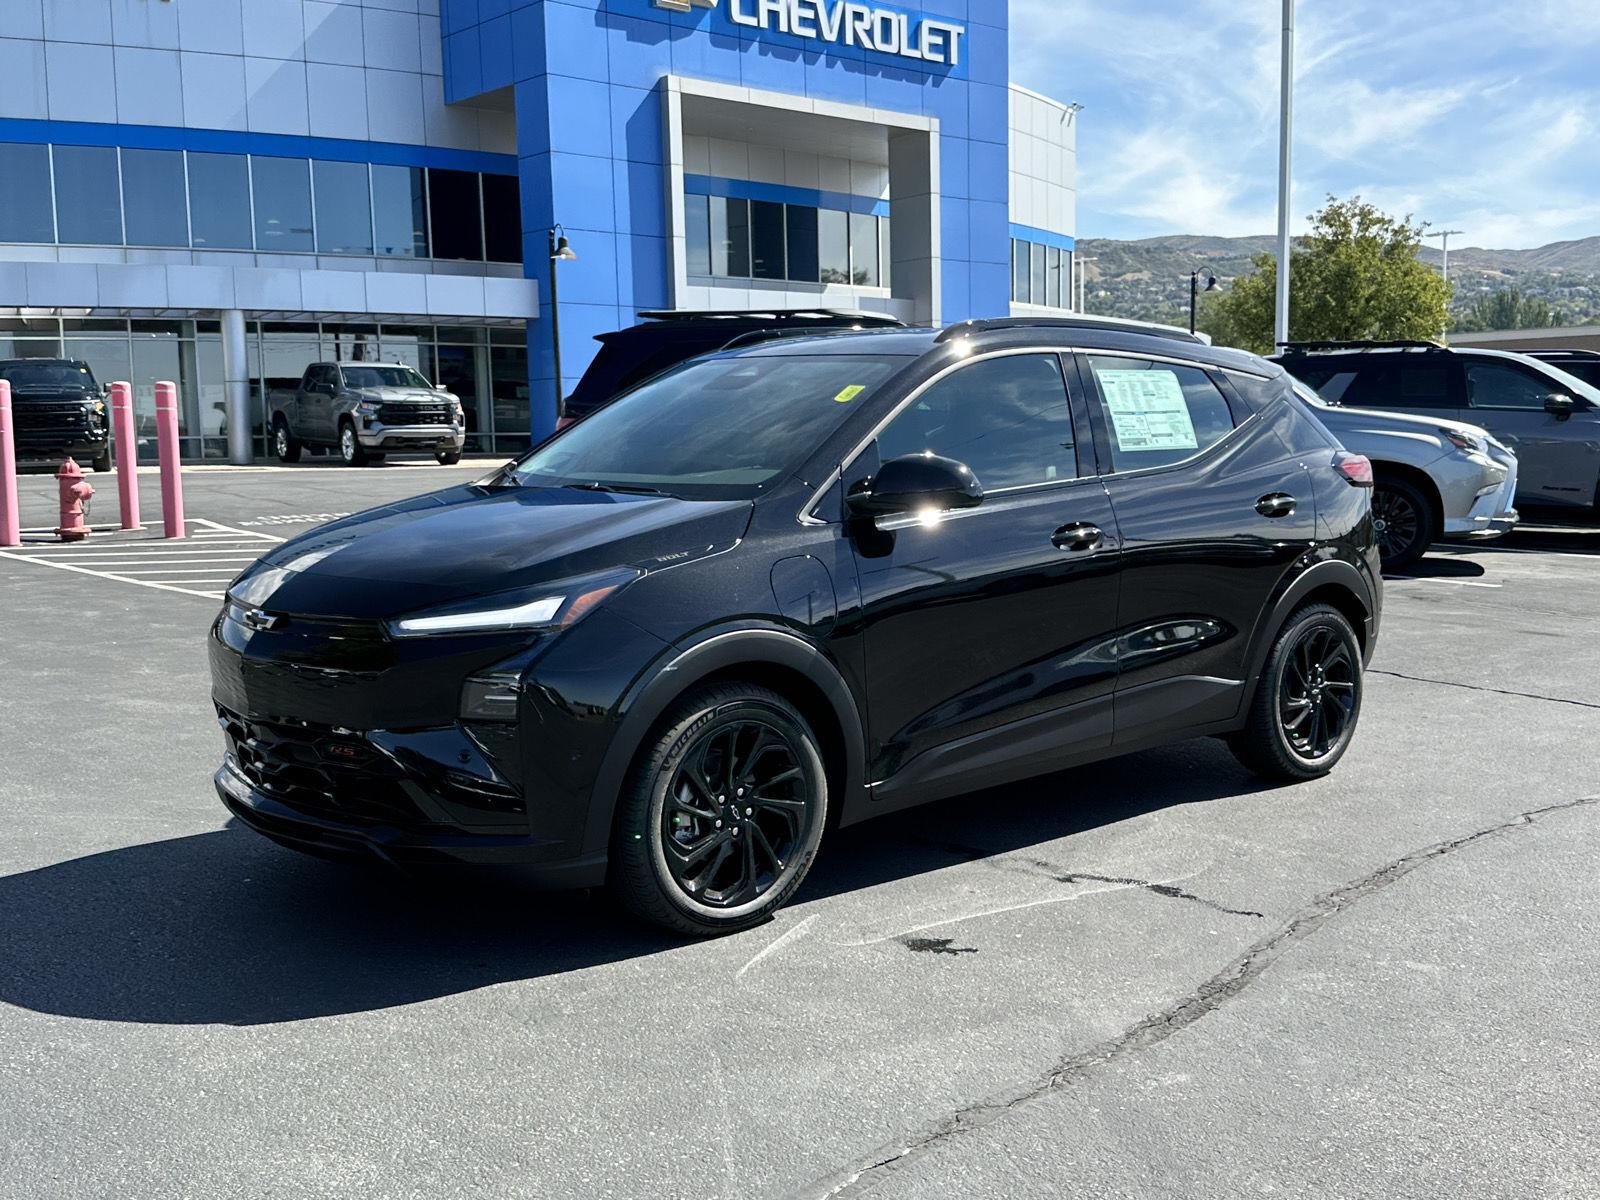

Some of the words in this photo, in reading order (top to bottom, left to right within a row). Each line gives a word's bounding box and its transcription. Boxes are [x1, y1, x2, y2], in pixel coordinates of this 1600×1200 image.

[730, 0, 965, 65] CHEVROLET
[656, 551, 689, 561] BOLT
[670, 709, 715, 759] MICHELIN
